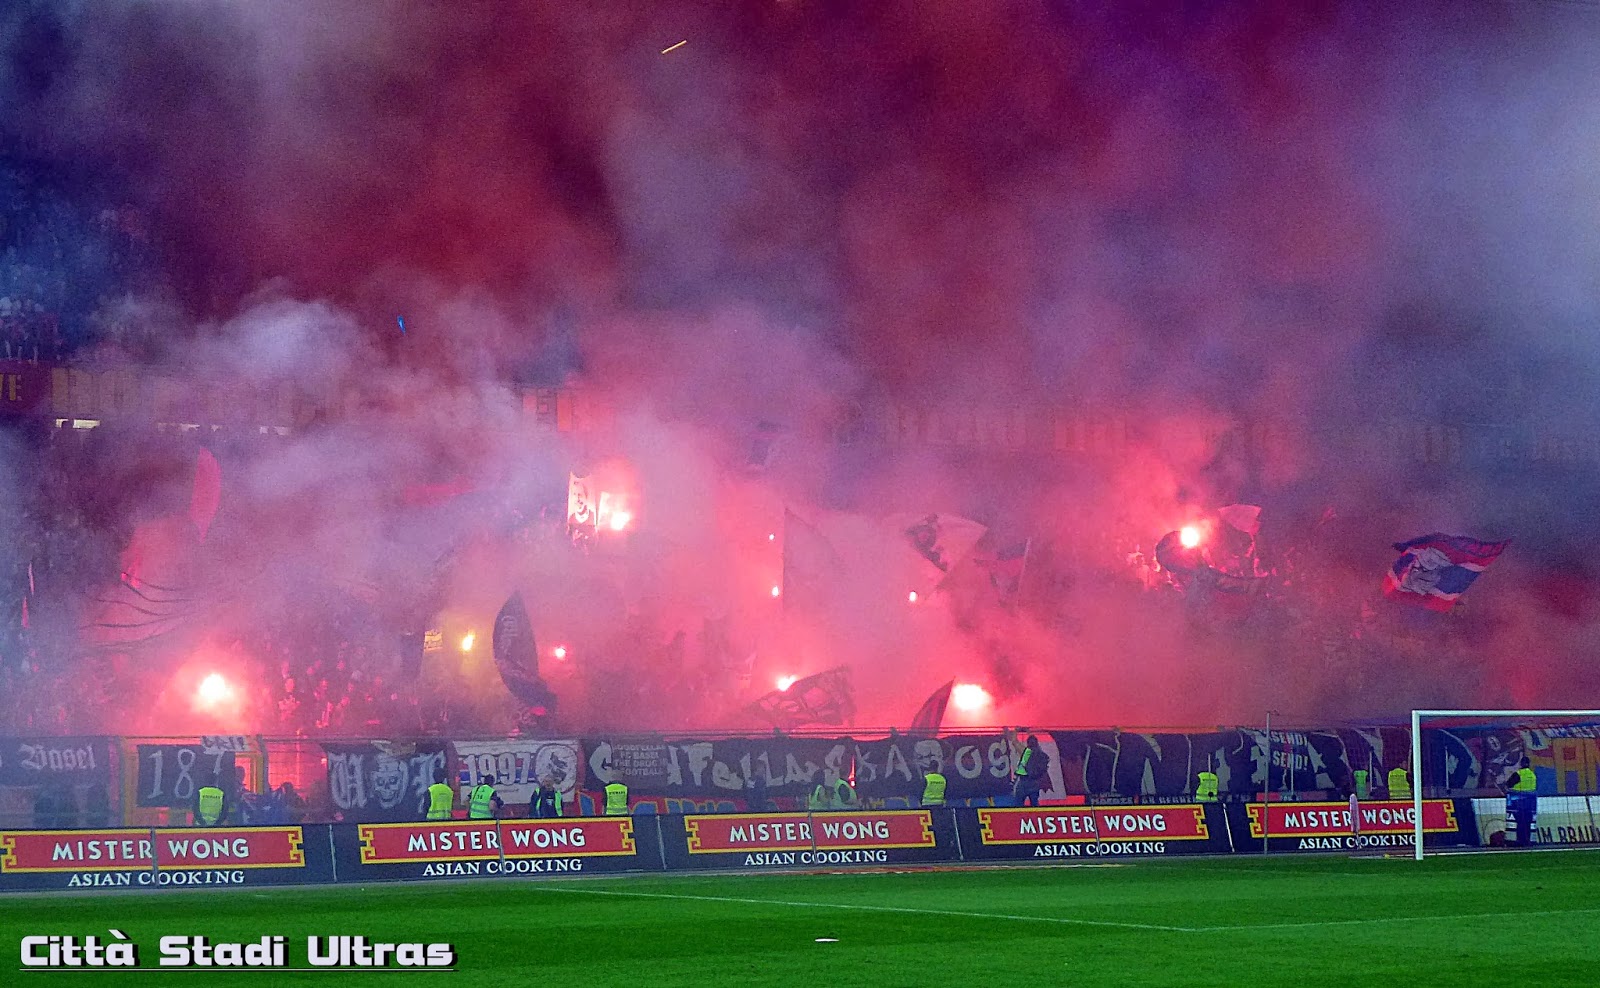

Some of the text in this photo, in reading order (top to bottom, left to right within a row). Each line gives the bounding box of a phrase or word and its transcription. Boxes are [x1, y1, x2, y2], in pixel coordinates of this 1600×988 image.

[463, 753, 531, 787] 1997
[633, 760, 658, 768] DRUG
[1272, 750, 1308, 770] SEND!
[1020, 814, 1167, 834] MISTER WONG
[1284, 808, 1417, 829] MISTER WONG
[408, 828, 586, 851] MISTER WONG
[729, 821, 890, 843] MISTER WONG
[52, 838, 250, 861] MISTER WONG
[1034, 842, 1165, 857] ASIAN COOKING
[1299, 836, 1342, 850] ASIAN
[423, 859, 583, 876] ASIAN COOKING
[744, 851, 888, 866] ASIAN COOKING
[68, 871, 245, 887] ASIAN COOKING
